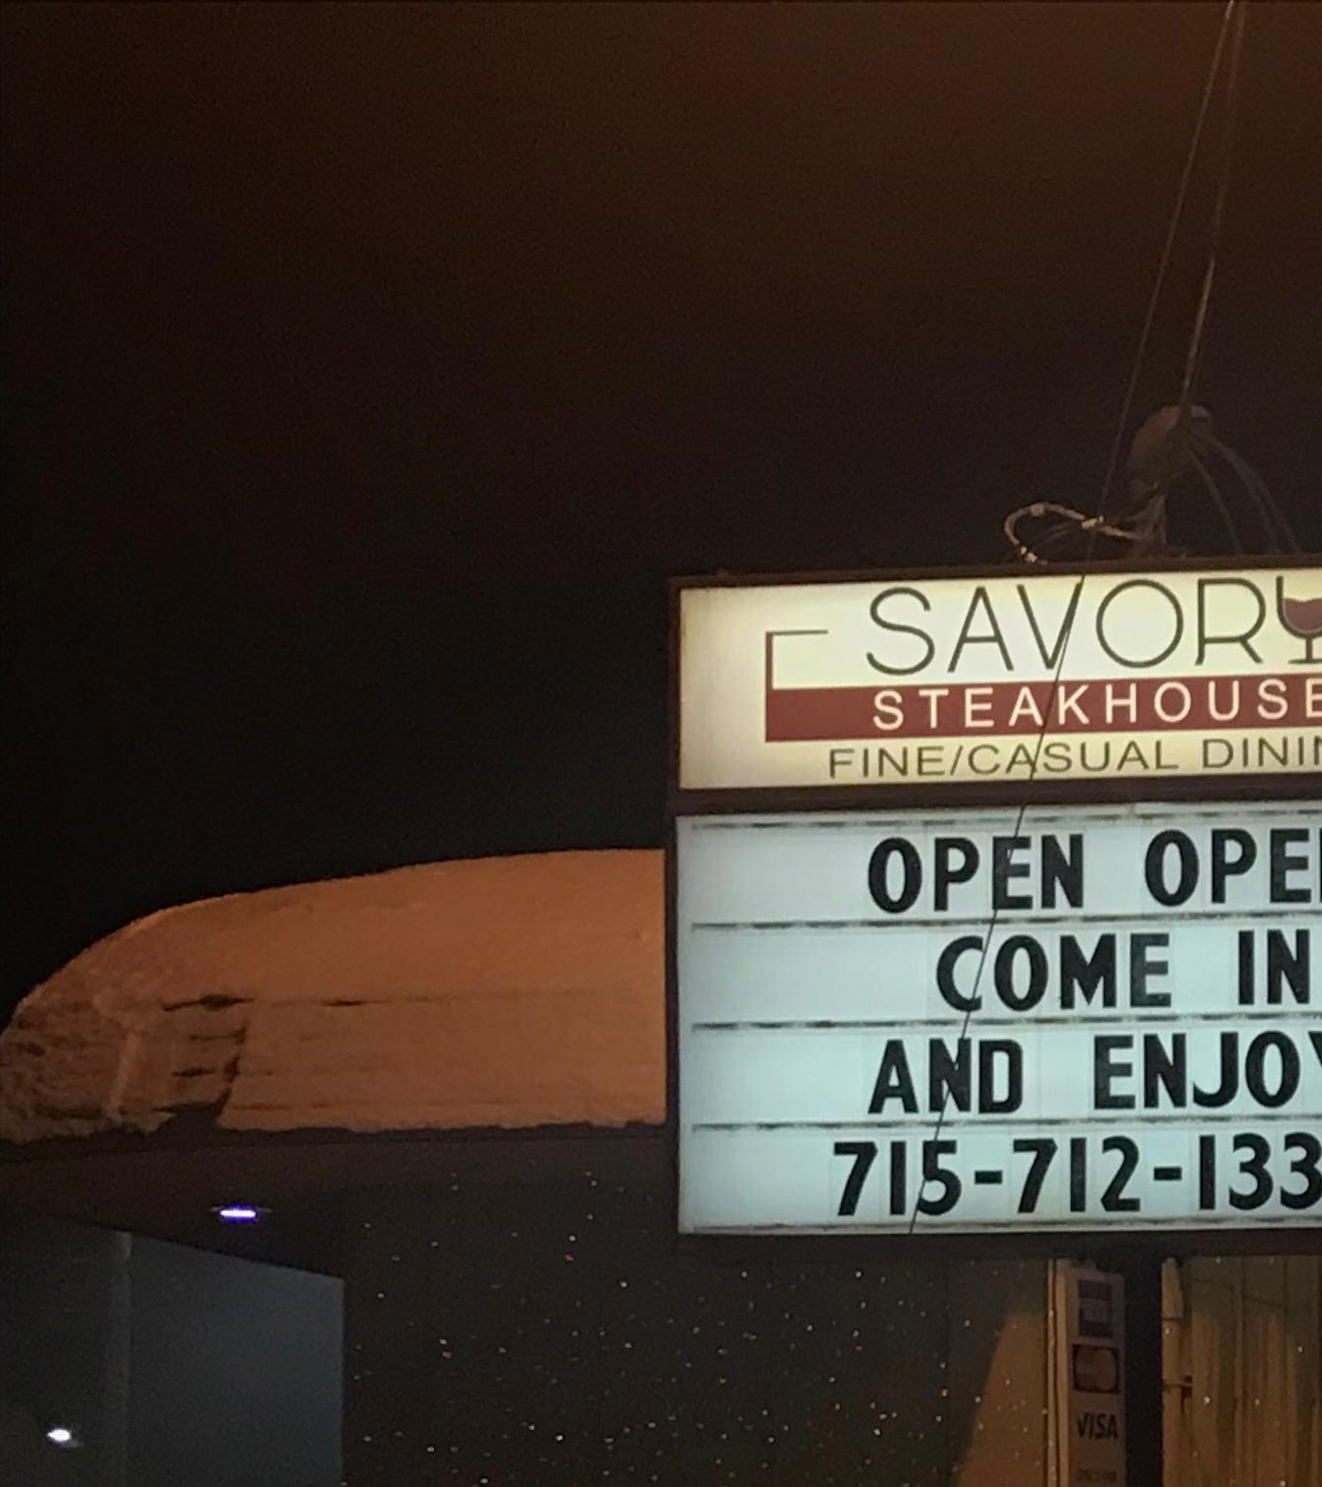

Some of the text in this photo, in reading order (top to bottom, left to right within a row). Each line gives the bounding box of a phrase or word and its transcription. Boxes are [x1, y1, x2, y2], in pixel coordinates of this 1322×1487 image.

[829, 738, 1178, 778] FINE/CASUAL
[868, 833, 1085, 912] OPEN
[937, 930, 1310, 1011] COME IN
[868, 1037, 1024, 1114] AND
[1077, 1411, 1118, 1439] VISA
